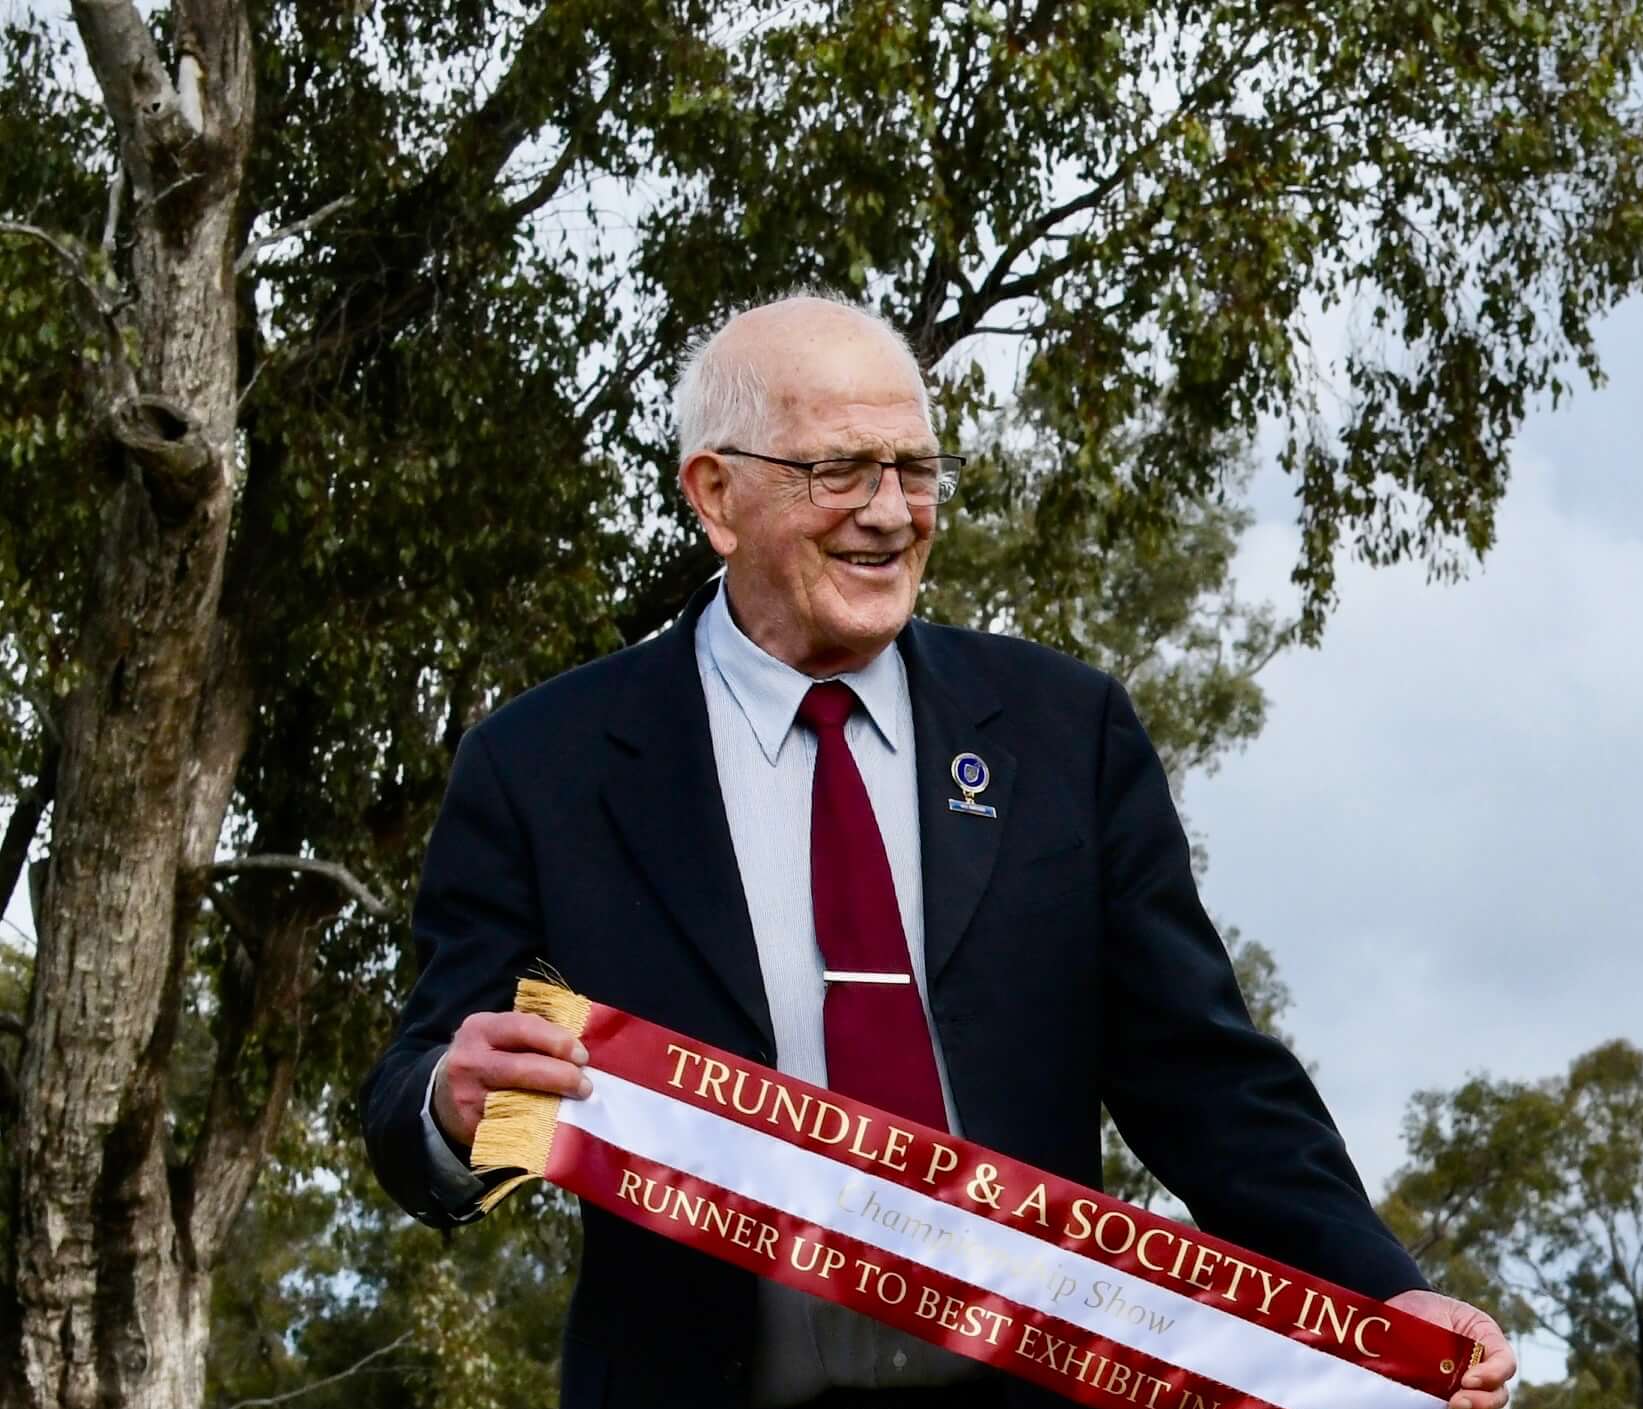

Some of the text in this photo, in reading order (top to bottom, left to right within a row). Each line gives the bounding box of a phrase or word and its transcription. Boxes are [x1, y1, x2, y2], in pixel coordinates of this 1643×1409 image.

[617, 1169, 777, 1261] RUNNER
[790, 1236, 848, 1281] UP
[854, 1259, 908, 1305] TO
[914, 1286, 1013, 1345] BEST
[667, 1043, 1391, 1358] TRUNDLE P & A SOCIETY INC
[838, 1183, 1176, 1336] Champip Show
